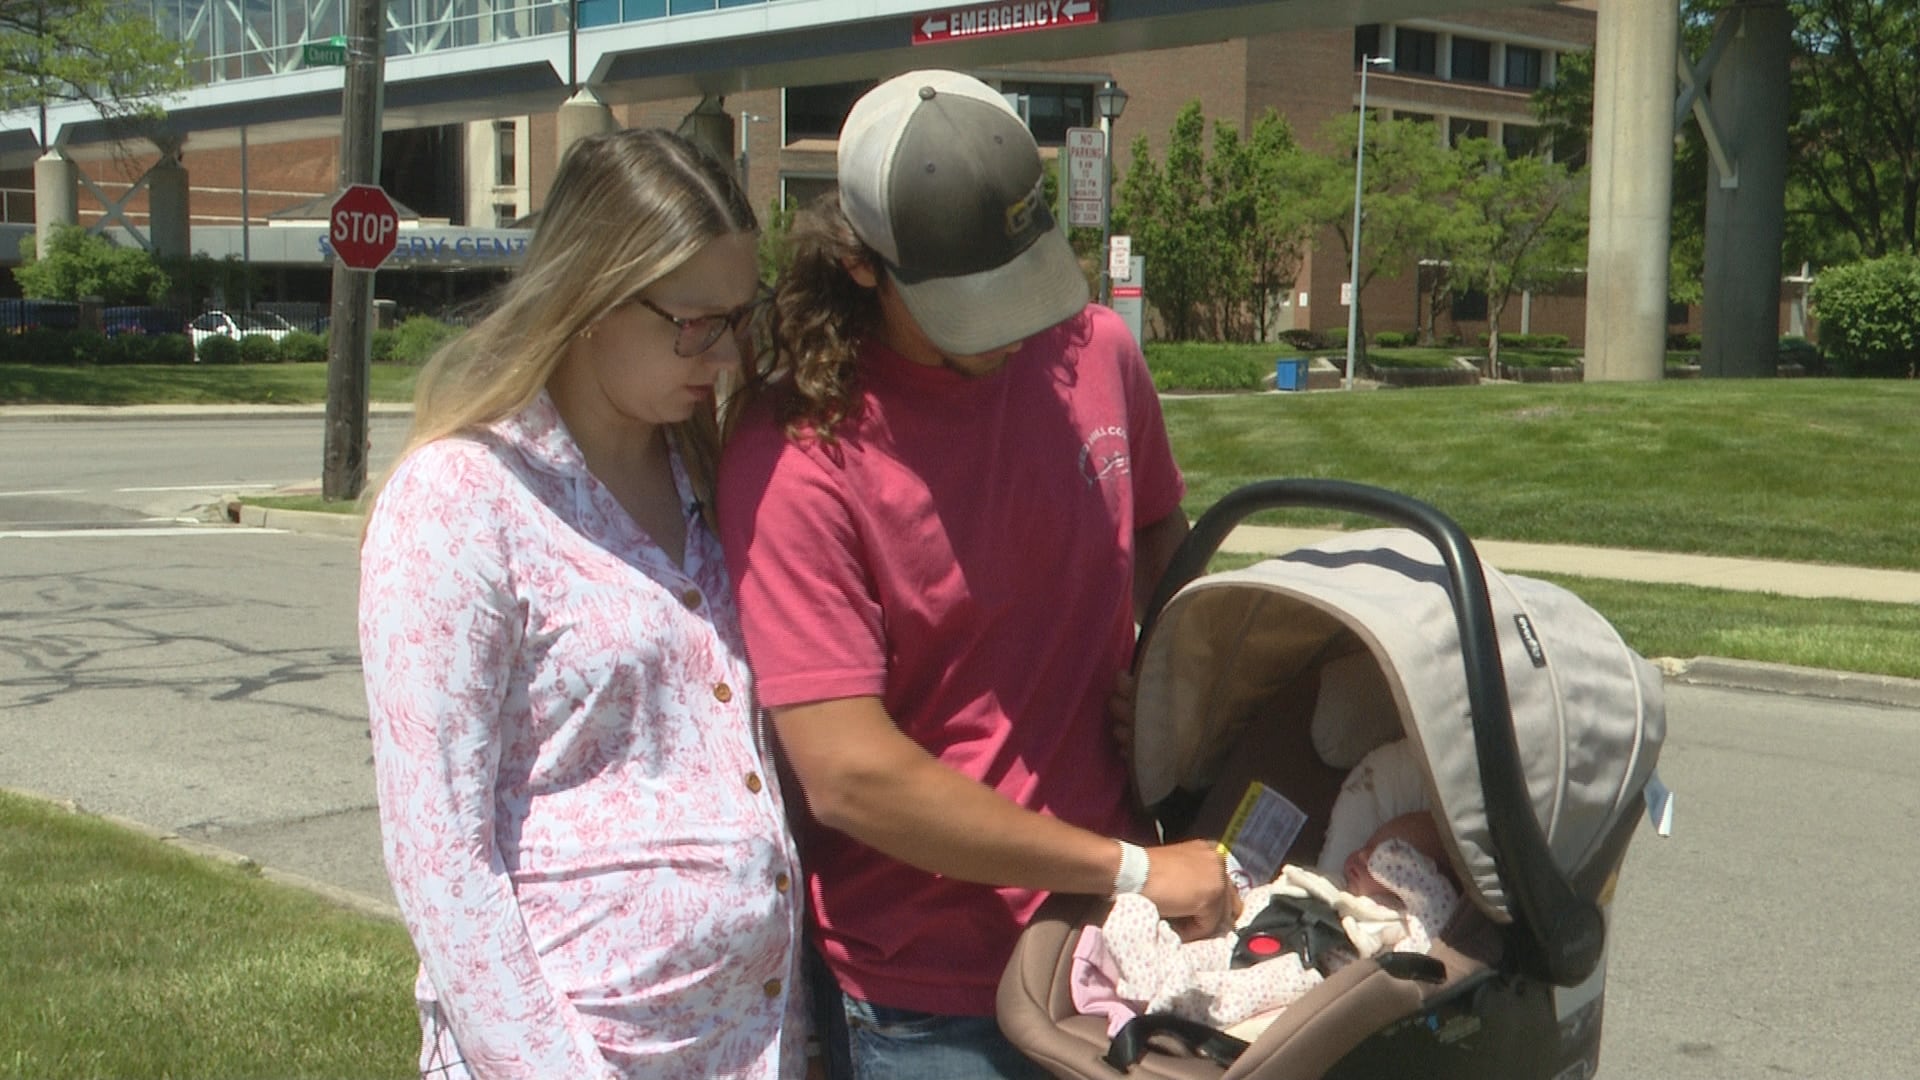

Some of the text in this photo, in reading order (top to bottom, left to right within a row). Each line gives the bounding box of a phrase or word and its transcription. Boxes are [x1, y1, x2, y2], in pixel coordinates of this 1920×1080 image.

[950, 0, 1060, 36] EMERGENCY
[1080, 134, 1093, 145] NO
[1071, 147, 1102, 159] PARKING
[334, 211, 394, 244] STOP
[318, 234, 528, 258] SERY CENT
